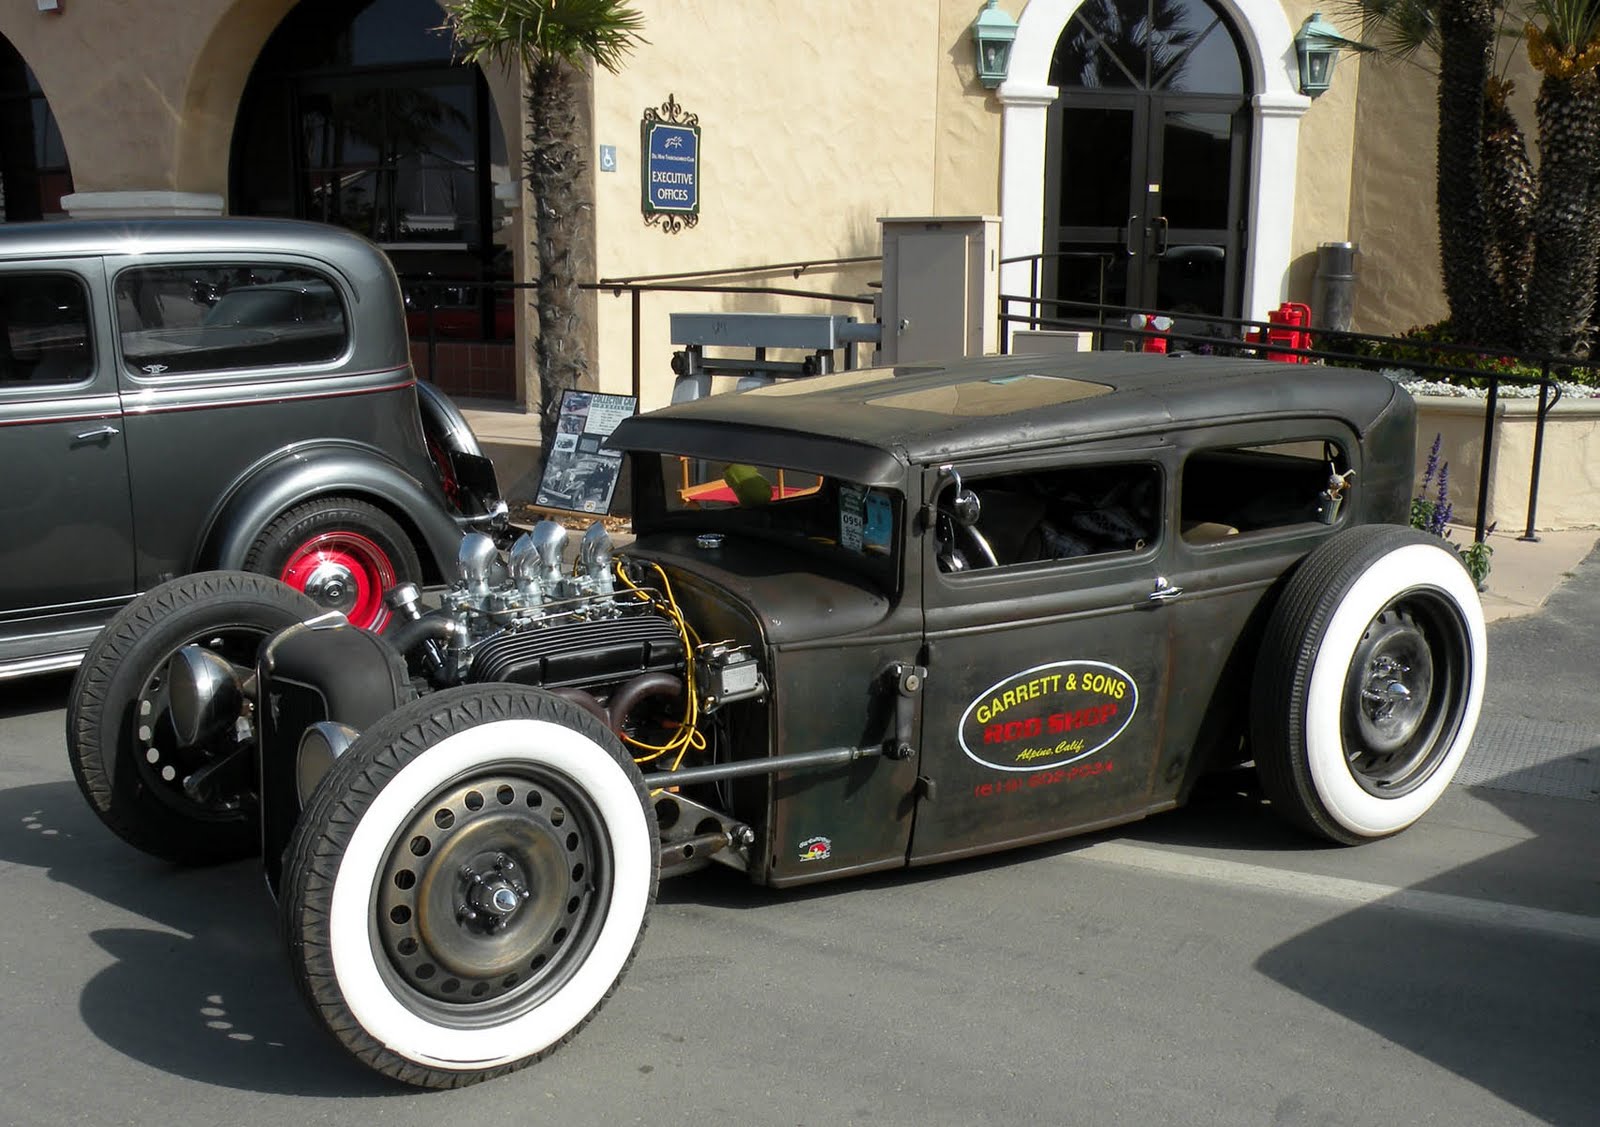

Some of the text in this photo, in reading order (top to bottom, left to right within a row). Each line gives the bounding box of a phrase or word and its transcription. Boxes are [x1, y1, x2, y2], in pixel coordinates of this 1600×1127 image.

[652, 171, 693, 184] EXECUTIVE
[657, 188, 689, 201] OFFICES
[976, 672, 1127, 724] GARRETT & SONS
[983, 703, 1118, 745] ROD SHOP
